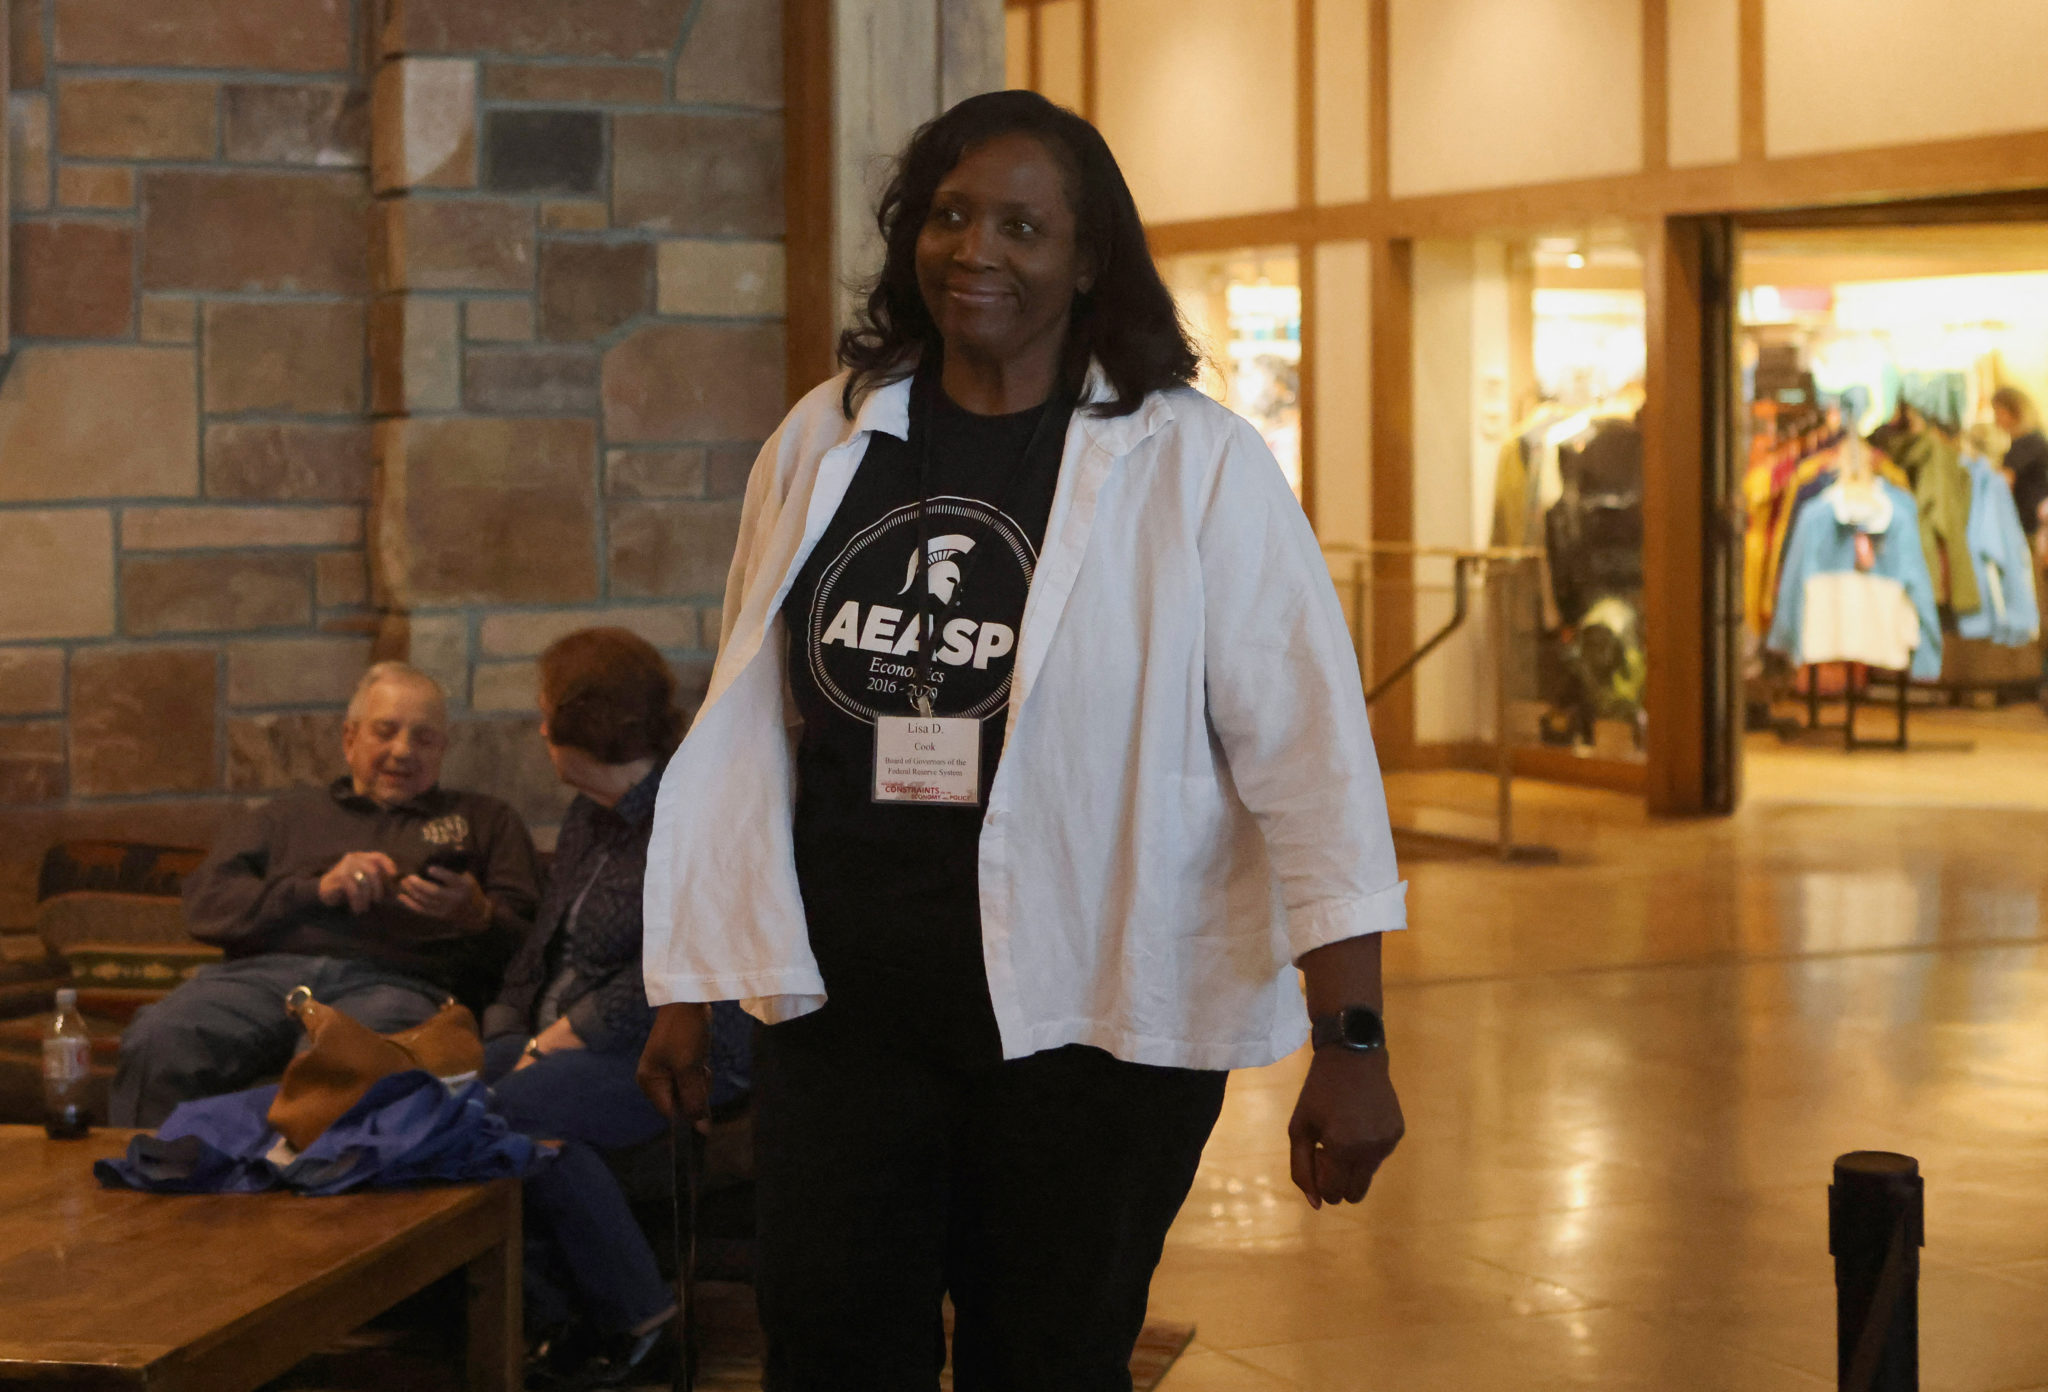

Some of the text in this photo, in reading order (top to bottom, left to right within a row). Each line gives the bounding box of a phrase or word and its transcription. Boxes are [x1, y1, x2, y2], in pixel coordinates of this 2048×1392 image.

[821, 600, 1014, 670] AEASP
[869, 656, 945, 683] Econoics
[866, 677, 897, 694] 2016
[907, 722, 944, 735] Lisa D.
[914, 742, 936, 752] Cook
[885, 757, 904, 765] Board
[905, 757, 913, 765] of
[913, 758, 946, 766] Governors
[888, 767, 963, 777] Federal Reserve System
[885, 785, 940, 795] CONSTRAINTS
